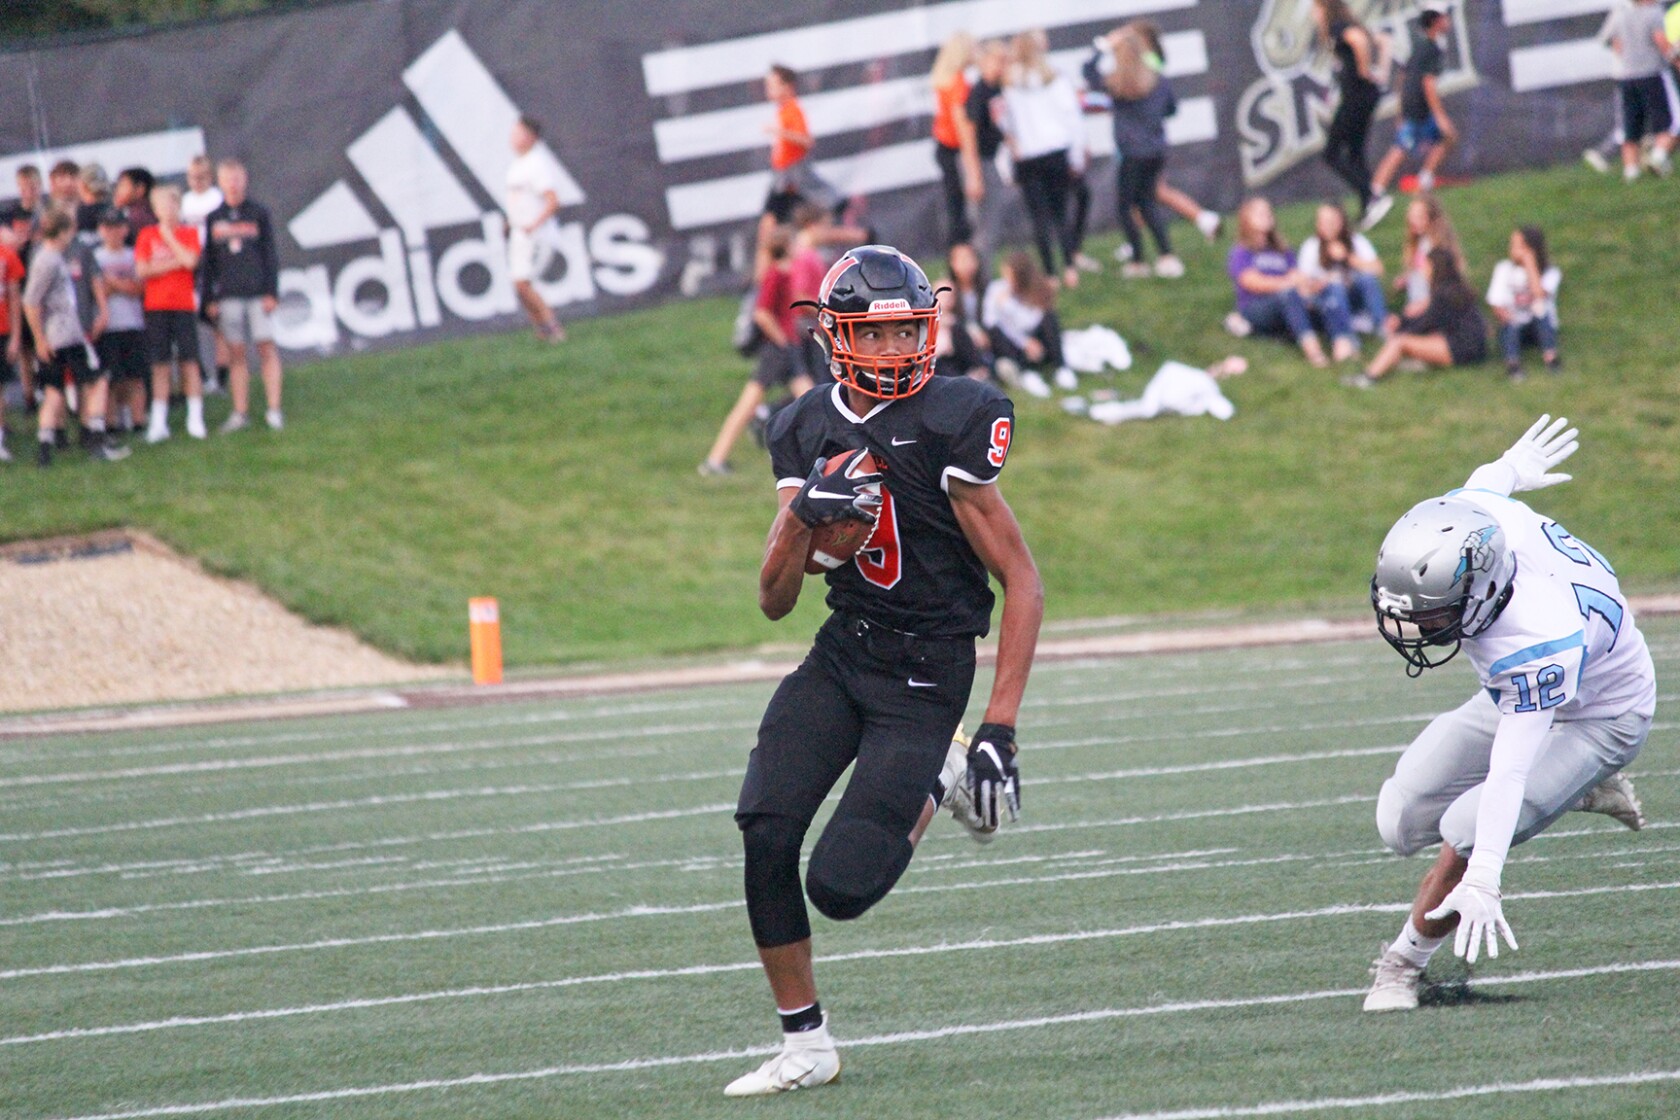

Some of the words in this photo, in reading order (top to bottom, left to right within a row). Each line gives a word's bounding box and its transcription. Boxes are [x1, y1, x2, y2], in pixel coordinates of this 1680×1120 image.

[273, 211, 661, 351] adidas
[873, 301, 906, 310] Riddell
[987, 416, 1011, 468] 9
[1511, 663, 1566, 713] 12
